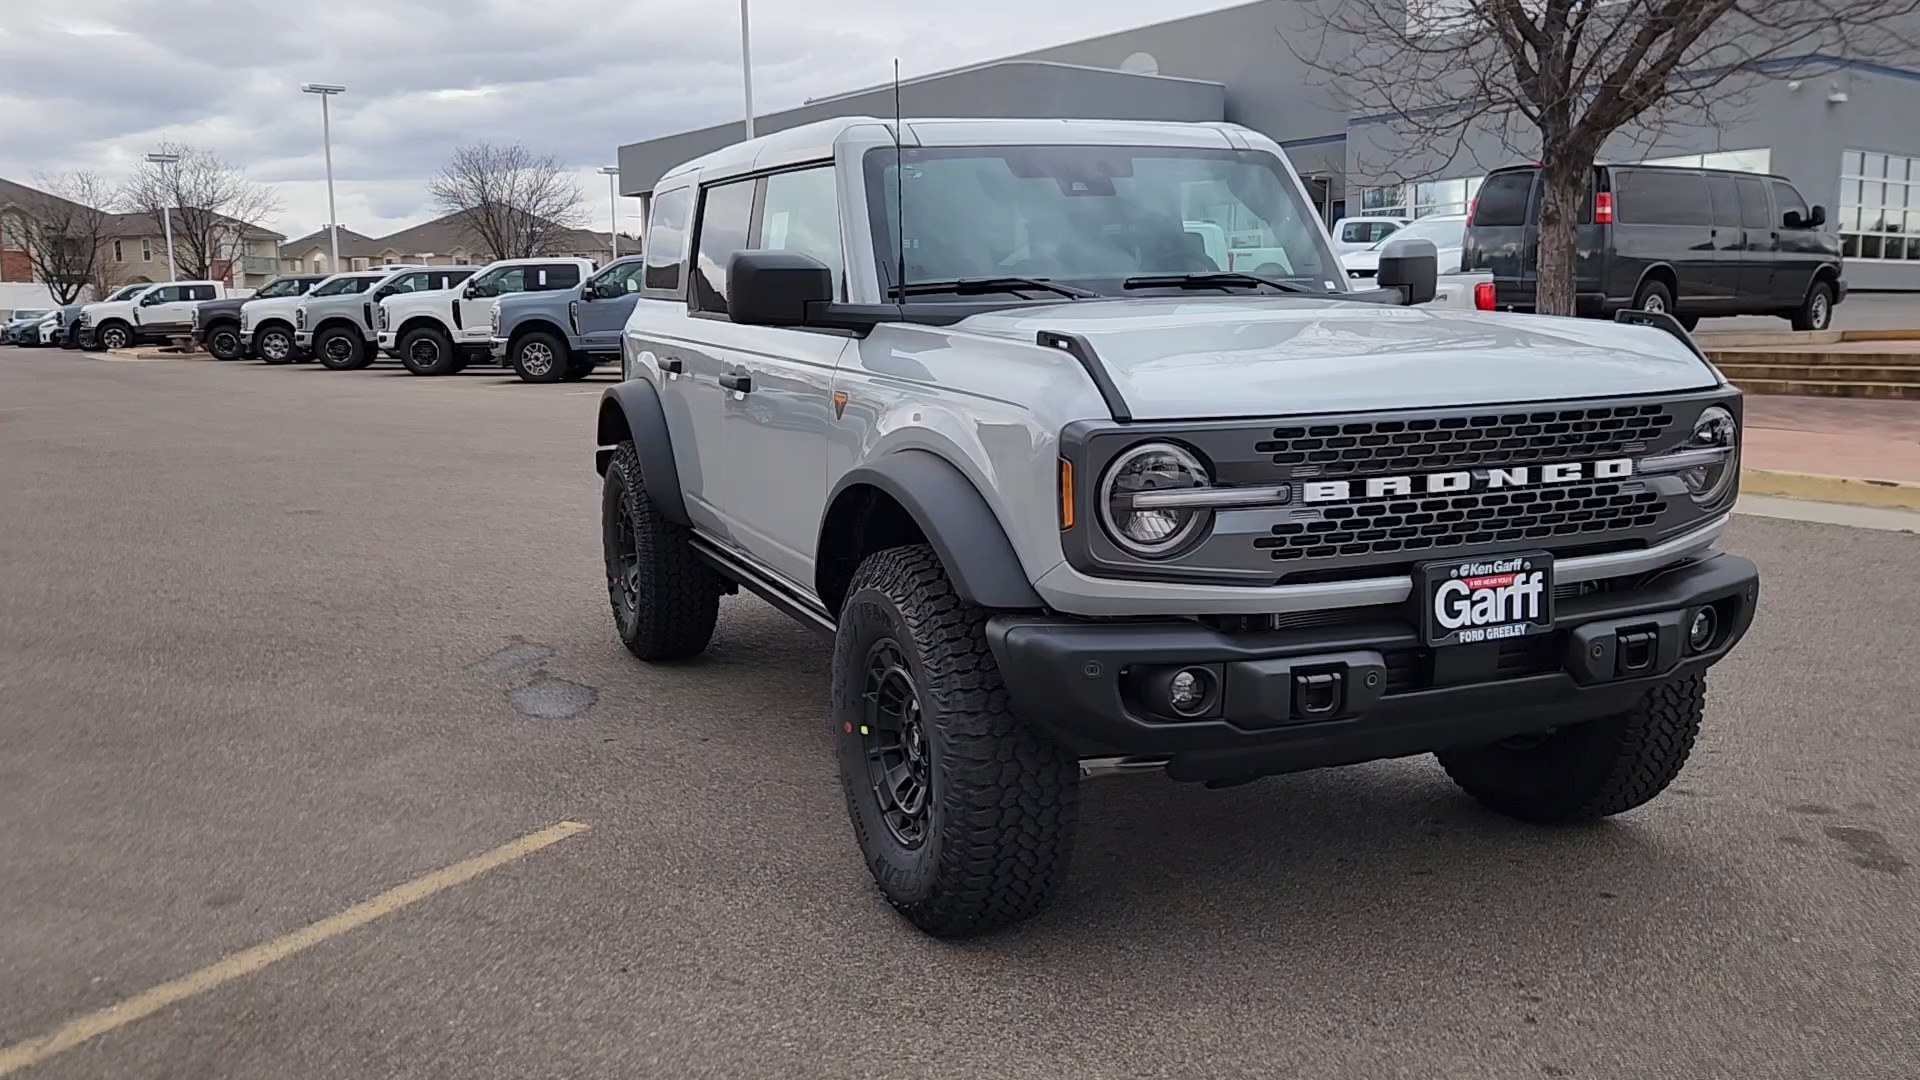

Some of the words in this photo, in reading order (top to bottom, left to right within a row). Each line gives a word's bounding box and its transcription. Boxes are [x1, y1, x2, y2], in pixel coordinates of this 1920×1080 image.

[1303, 458, 1632, 502] BRONCO
[1469, 563, 1492, 575] Ken
[1493, 558, 1523, 573] Garff
[1434, 571, 1543, 629] Garff
[1459, 630, 1485, 643] FORD
[1486, 624, 1526, 640] GREELEY
